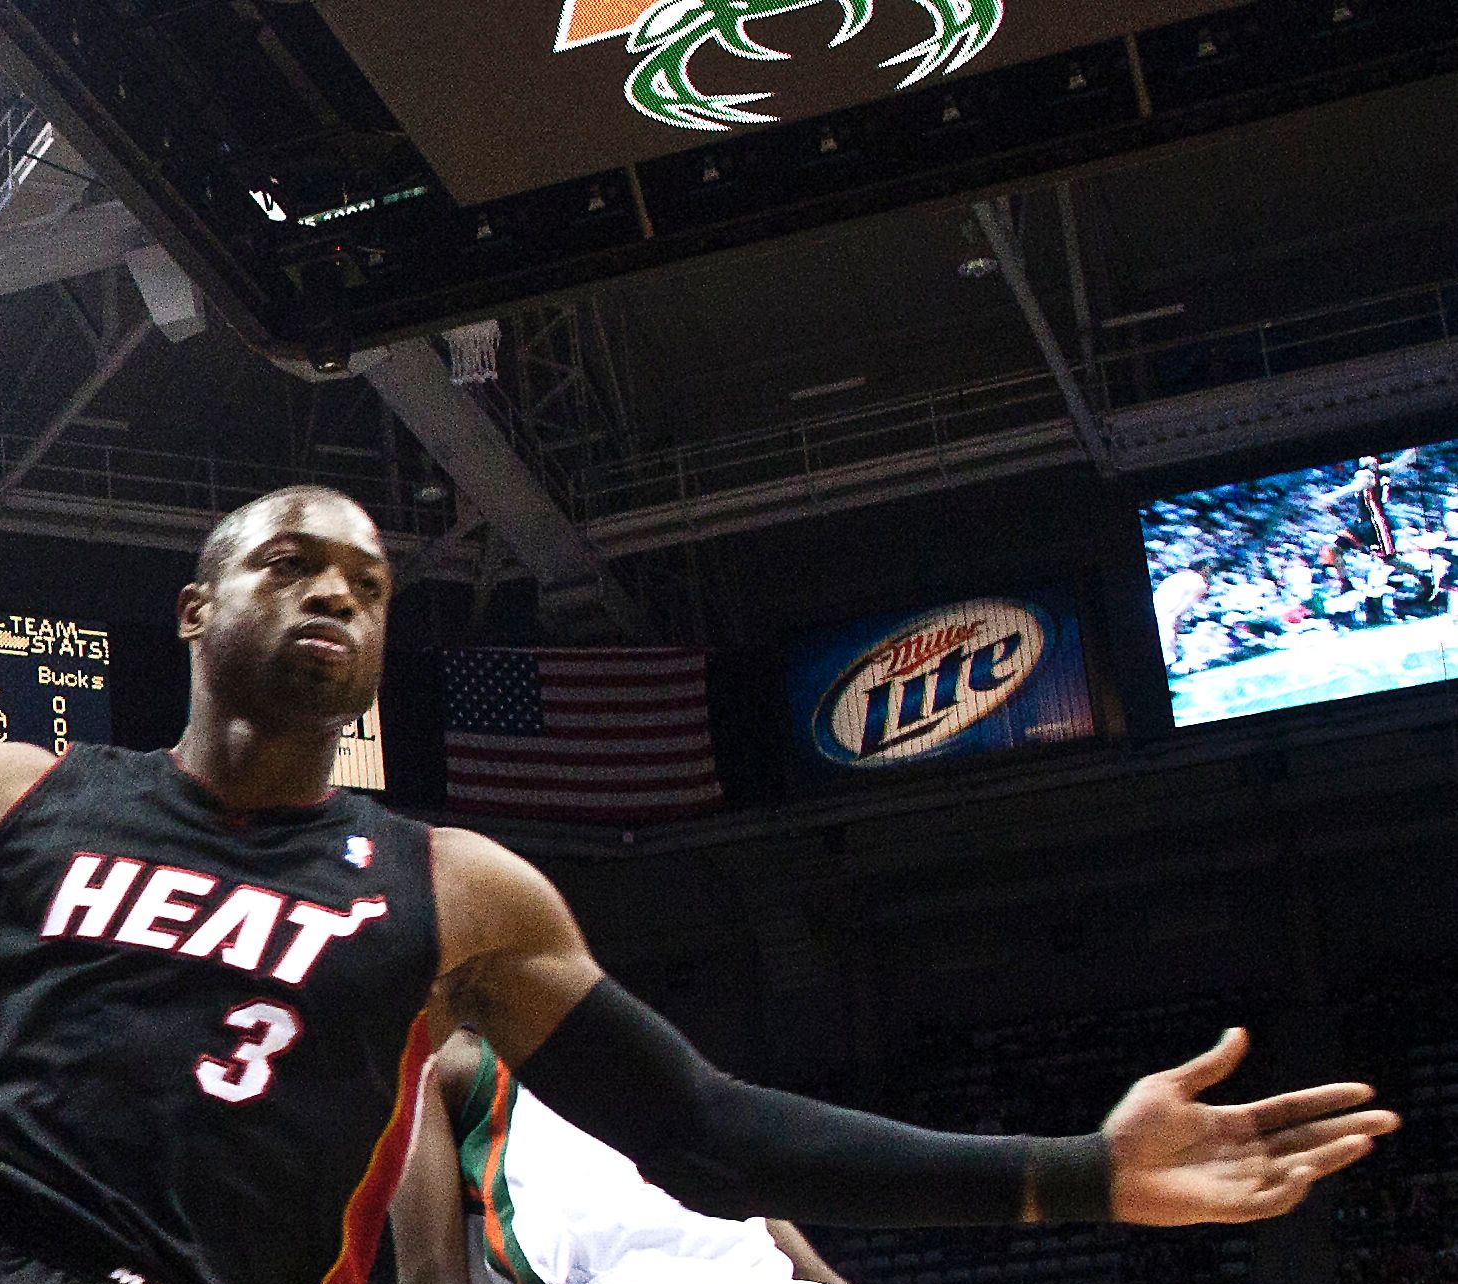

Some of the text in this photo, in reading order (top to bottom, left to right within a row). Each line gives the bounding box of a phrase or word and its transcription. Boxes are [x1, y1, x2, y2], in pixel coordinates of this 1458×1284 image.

[10, 615, 79, 640] TEAM
[38, 665, 104, 691] Bucks
[52, 695, 66, 714] 0
[857, 631, 1022, 760] Lite
[53, 717, 68, 736] 0
[41, 851, 388, 988] HEAT
[192, 997, 303, 1104] 3
